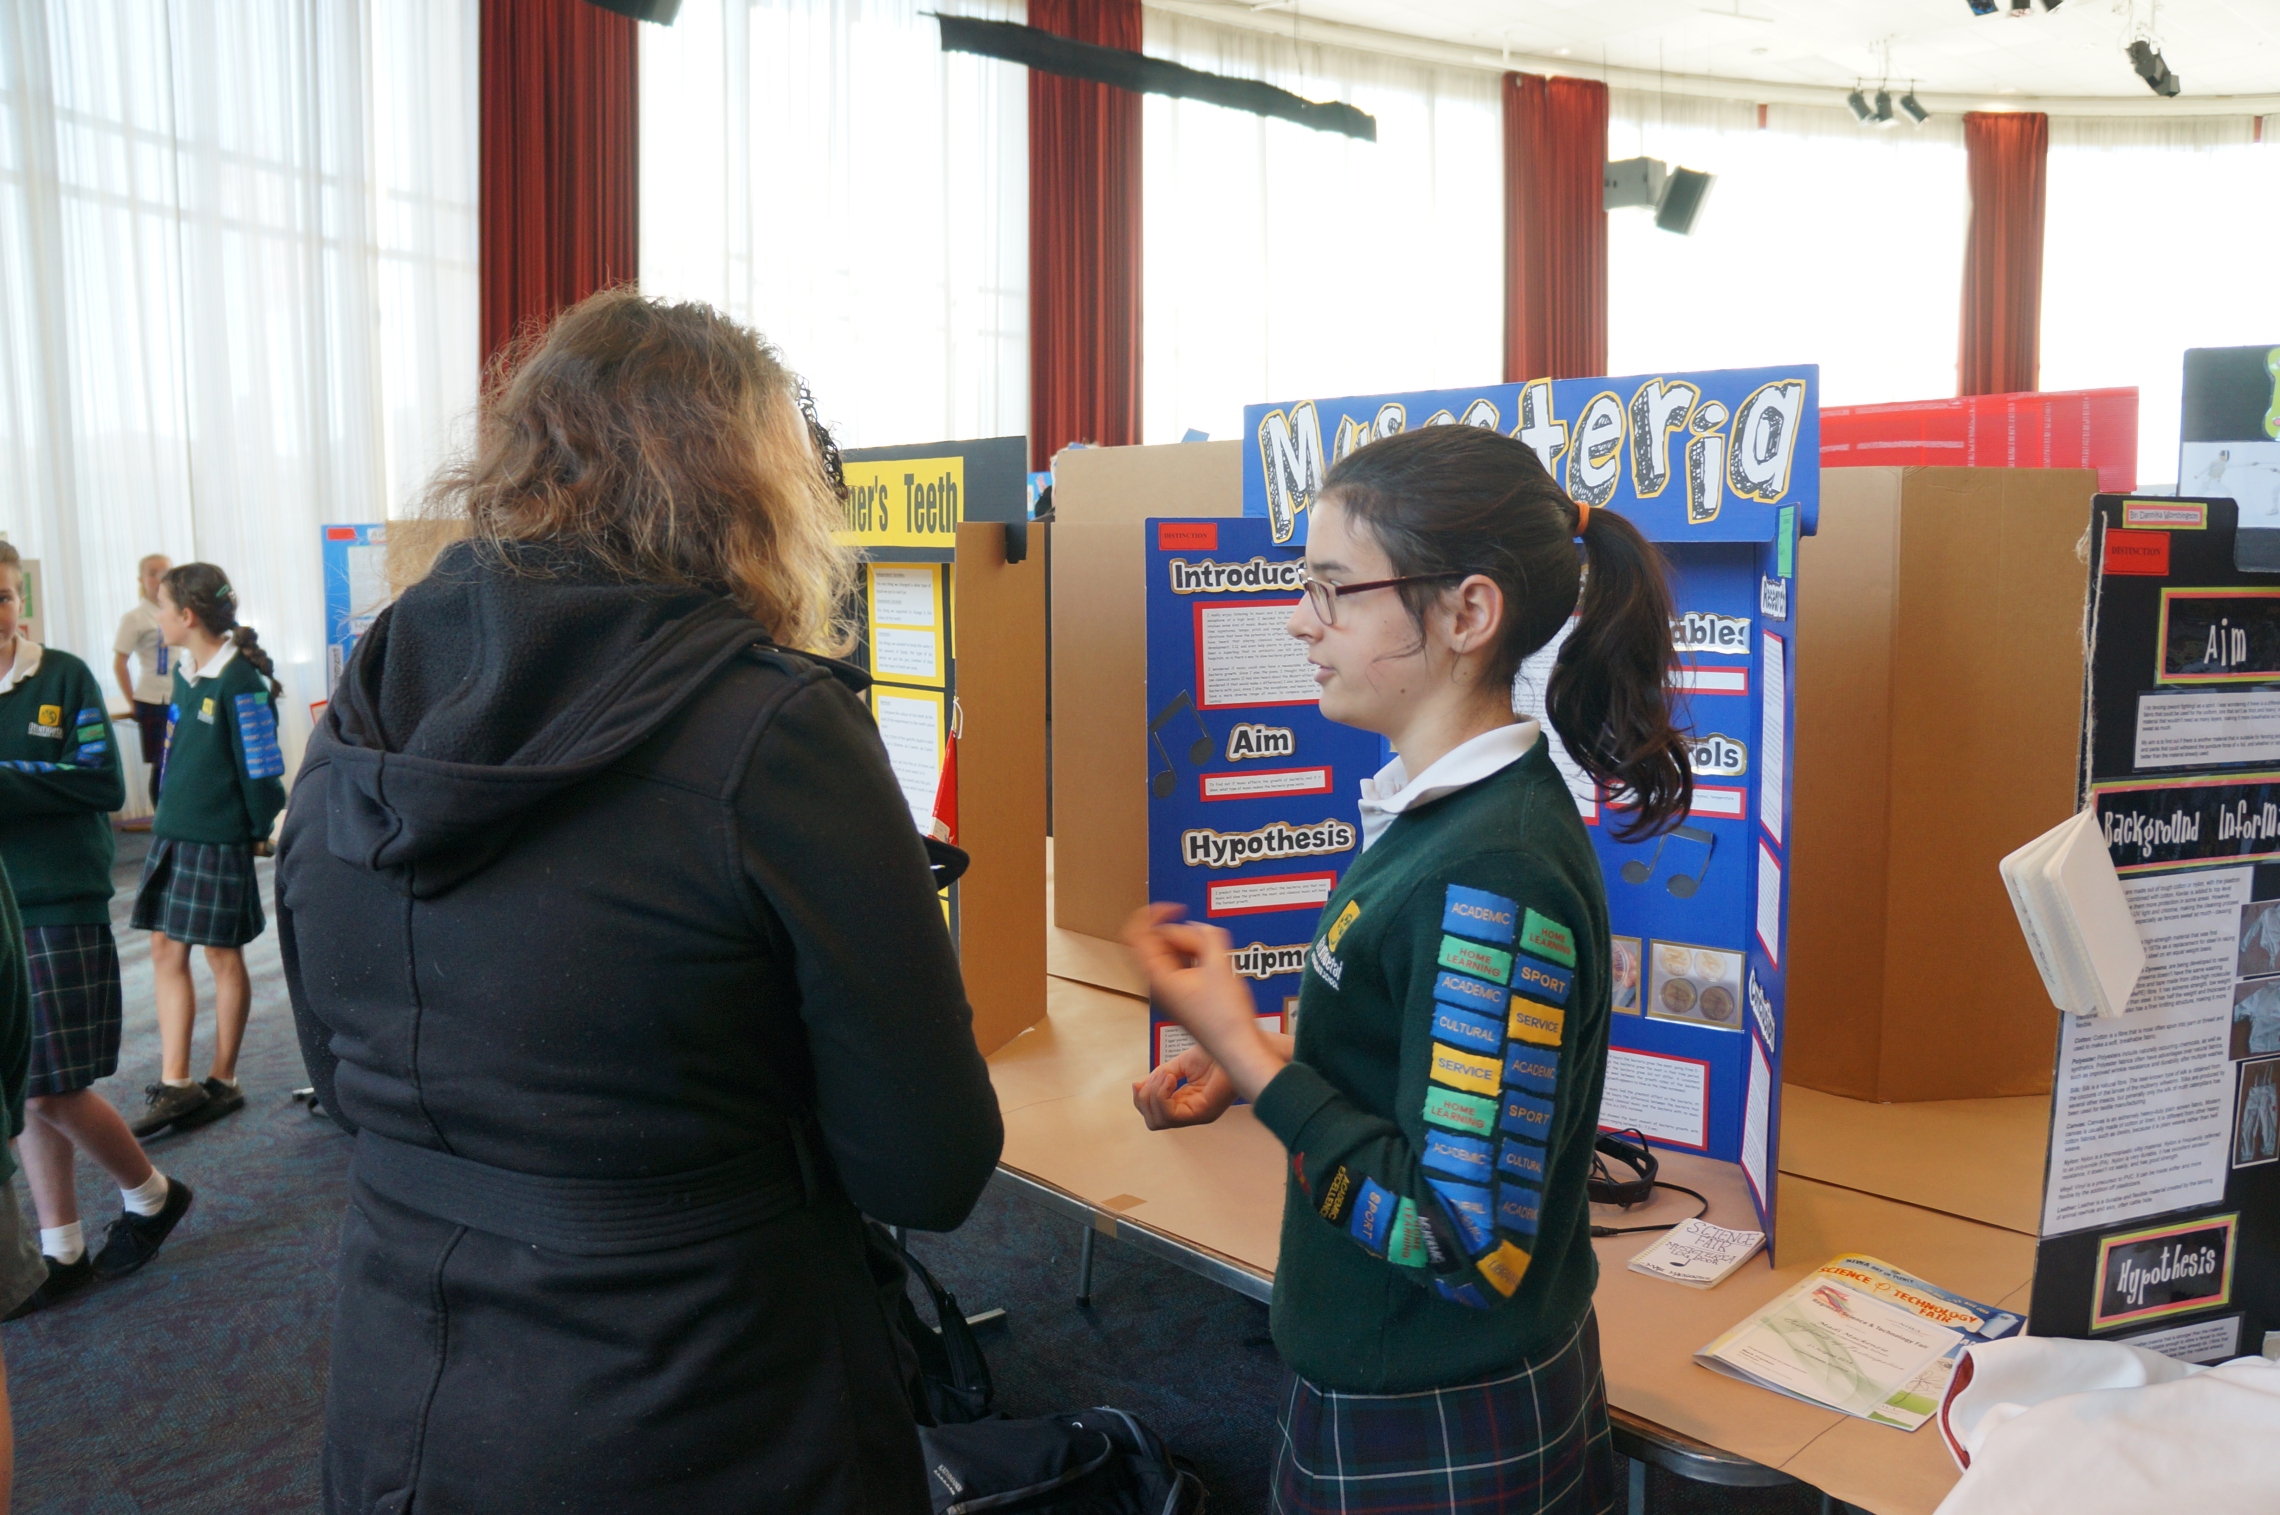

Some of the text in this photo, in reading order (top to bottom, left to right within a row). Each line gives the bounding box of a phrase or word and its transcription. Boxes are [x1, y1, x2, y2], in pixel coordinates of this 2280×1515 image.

[1259, 377, 1806, 543] Mteria
[904, 472, 957, 534] Teeth
[2112, 546, 2160, 556] DISTINCTION
[1174, 561, 1306, 588] Introduct
[2203, 617, 2248, 667] Aim
[1232, 729, 1289, 754] Aim
[2104, 799, 2280, 857] Background Inform
[1189, 823, 1350, 863] Hypothesis
[1451, 902, 1511, 925] ACADEMIC
[1529, 932, 1572, 955] LEARNING
[1541, 927, 1567, 942] HOME
[1446, 953, 1502, 977] LEARNING
[1460, 949, 1493, 964] HOME
[1441, 976, 1502, 1003] ACADEMIC
[1521, 966, 1567, 994] SPORT
[1438, 1016, 1495, 1042] CULTURAL
[1516, 1012, 1560, 1034] SERVICE
[1438, 1057, 1493, 1081] SERVICE
[1511, 1059, 1556, 1080] ACADEMIC
[1431, 1106, 1485, 1129] LEARNING
[1443, 1100, 1475, 1116] HOME
[1509, 1104, 1551, 1125] SPORT
[1433, 1142, 1487, 1166] ACADEMIC
[1506, 1153, 1542, 1173] CULTURAL
[1319, 1165, 1346, 1218] EXCELLENC
[1328, 1174, 1350, 1220] ACADEMIC
[1362, 1191, 1382, 1239] SPORT
[1402, 1207, 1413, 1259] LEARNING
[1686, 1222, 1760, 1246] SCIENCE
[1695, 1235, 1731, 1252] FAIR
[2116, 1244, 2216, 1305] Hypothesis
[1818, 1266, 1873, 1284] SCIENCE
[1893, 1289, 1979, 1324] TECHNOLOGY
[1919, 1308, 1952, 1324] FAIR
[1841, 1311, 1868, 1325] Science
[1875, 1325, 1914, 1345] Technology
[1915, 1341, 1930, 1350] Fair
